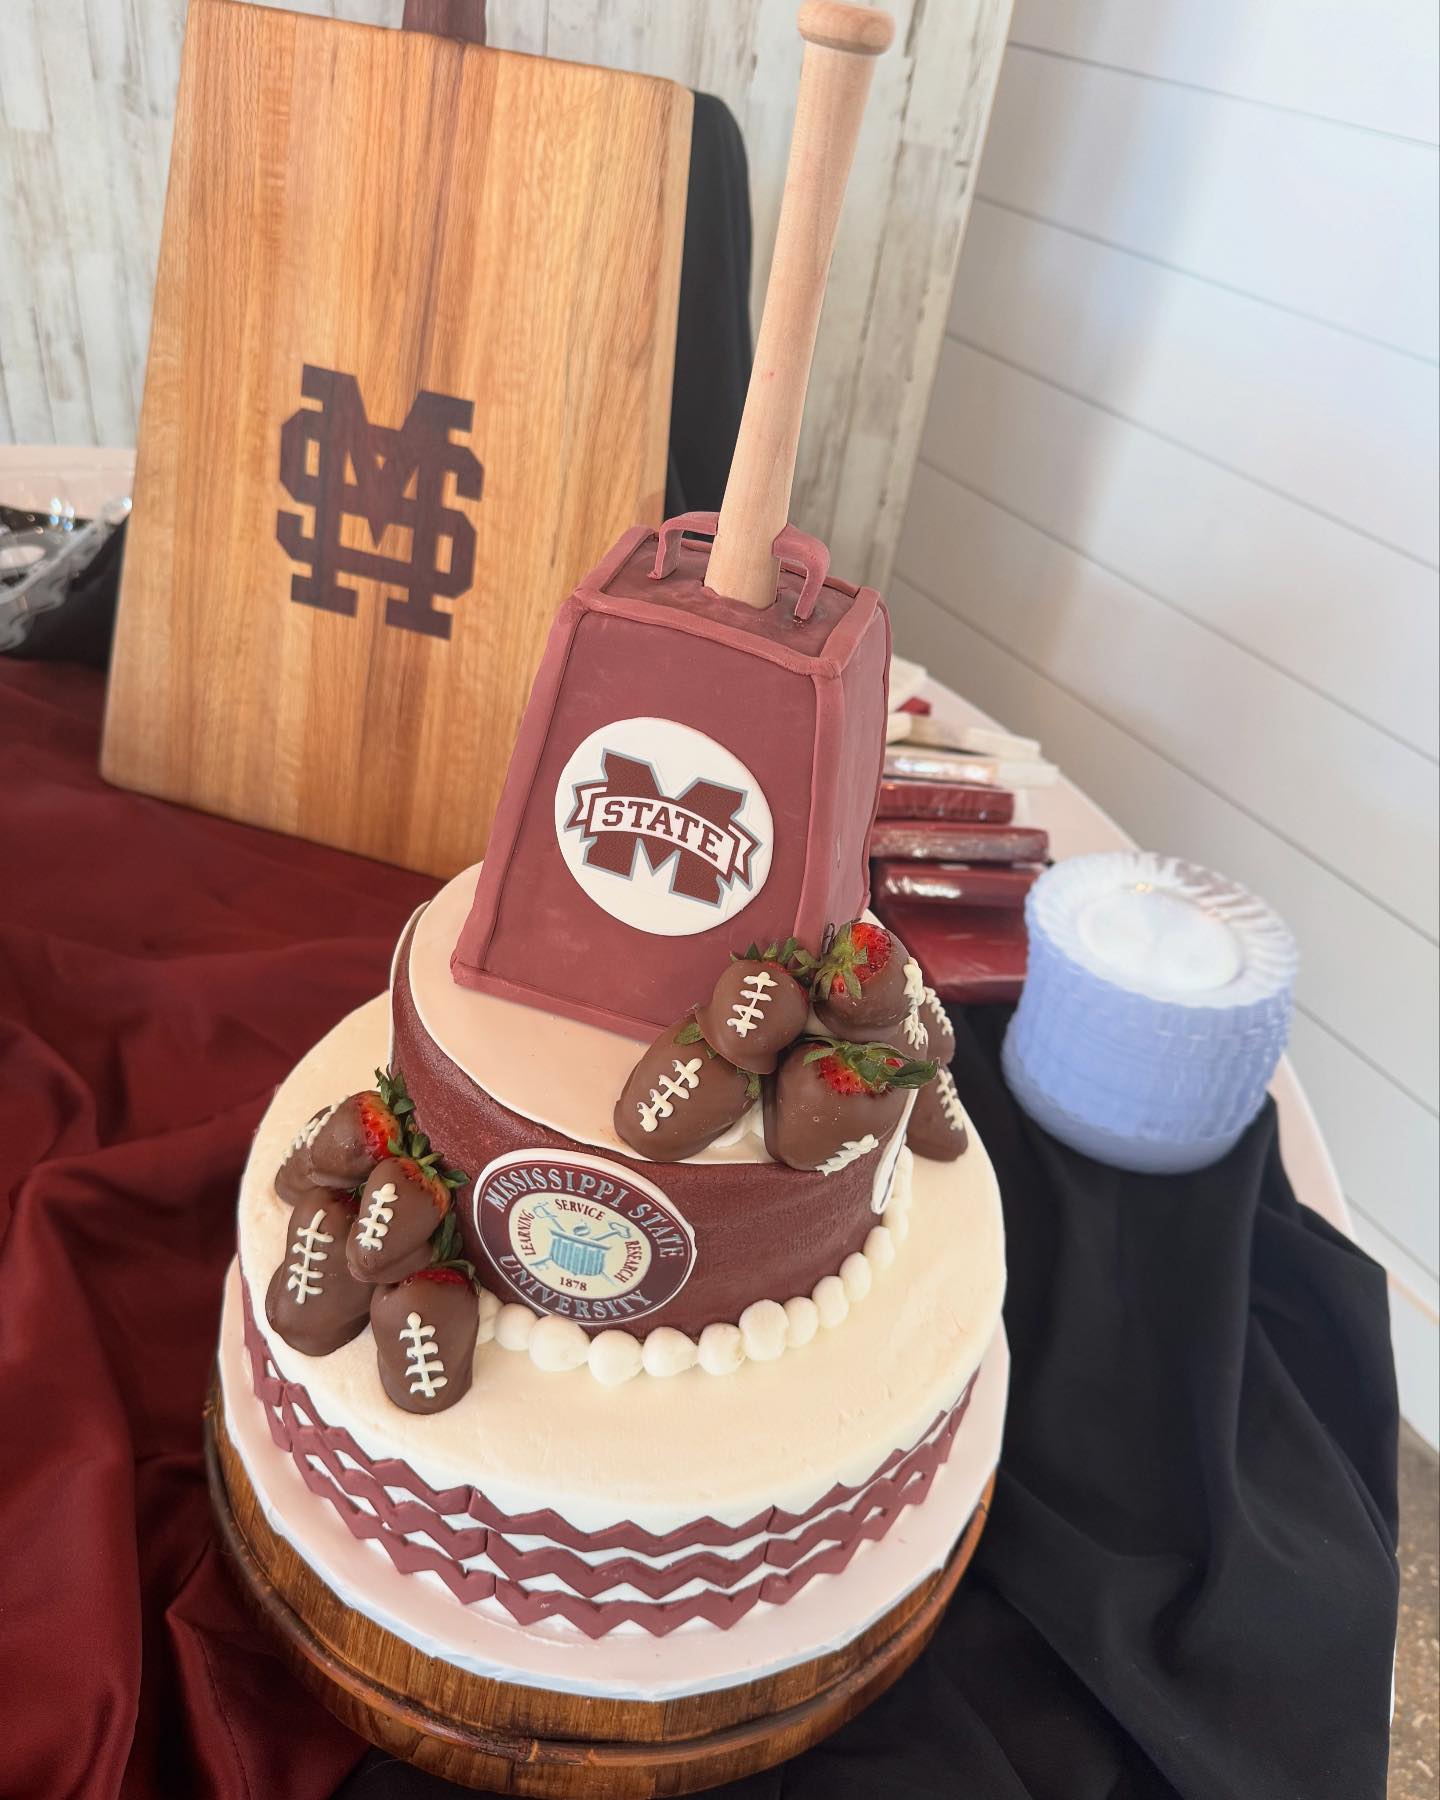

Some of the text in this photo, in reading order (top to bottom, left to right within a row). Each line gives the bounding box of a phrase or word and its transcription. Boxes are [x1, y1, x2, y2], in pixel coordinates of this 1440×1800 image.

[602, 800, 724, 862] STATE
[485, 1167, 684, 1258] MISSISSIPPI STATE
[517, 1208, 536, 1256] LEARNING
[555, 1198, 605, 1221] SERVICE
[559, 1276, 588, 1291] 1878
[614, 1240, 642, 1283] RESEARCH
[500, 1255, 652, 1319] UNIVERSITY
